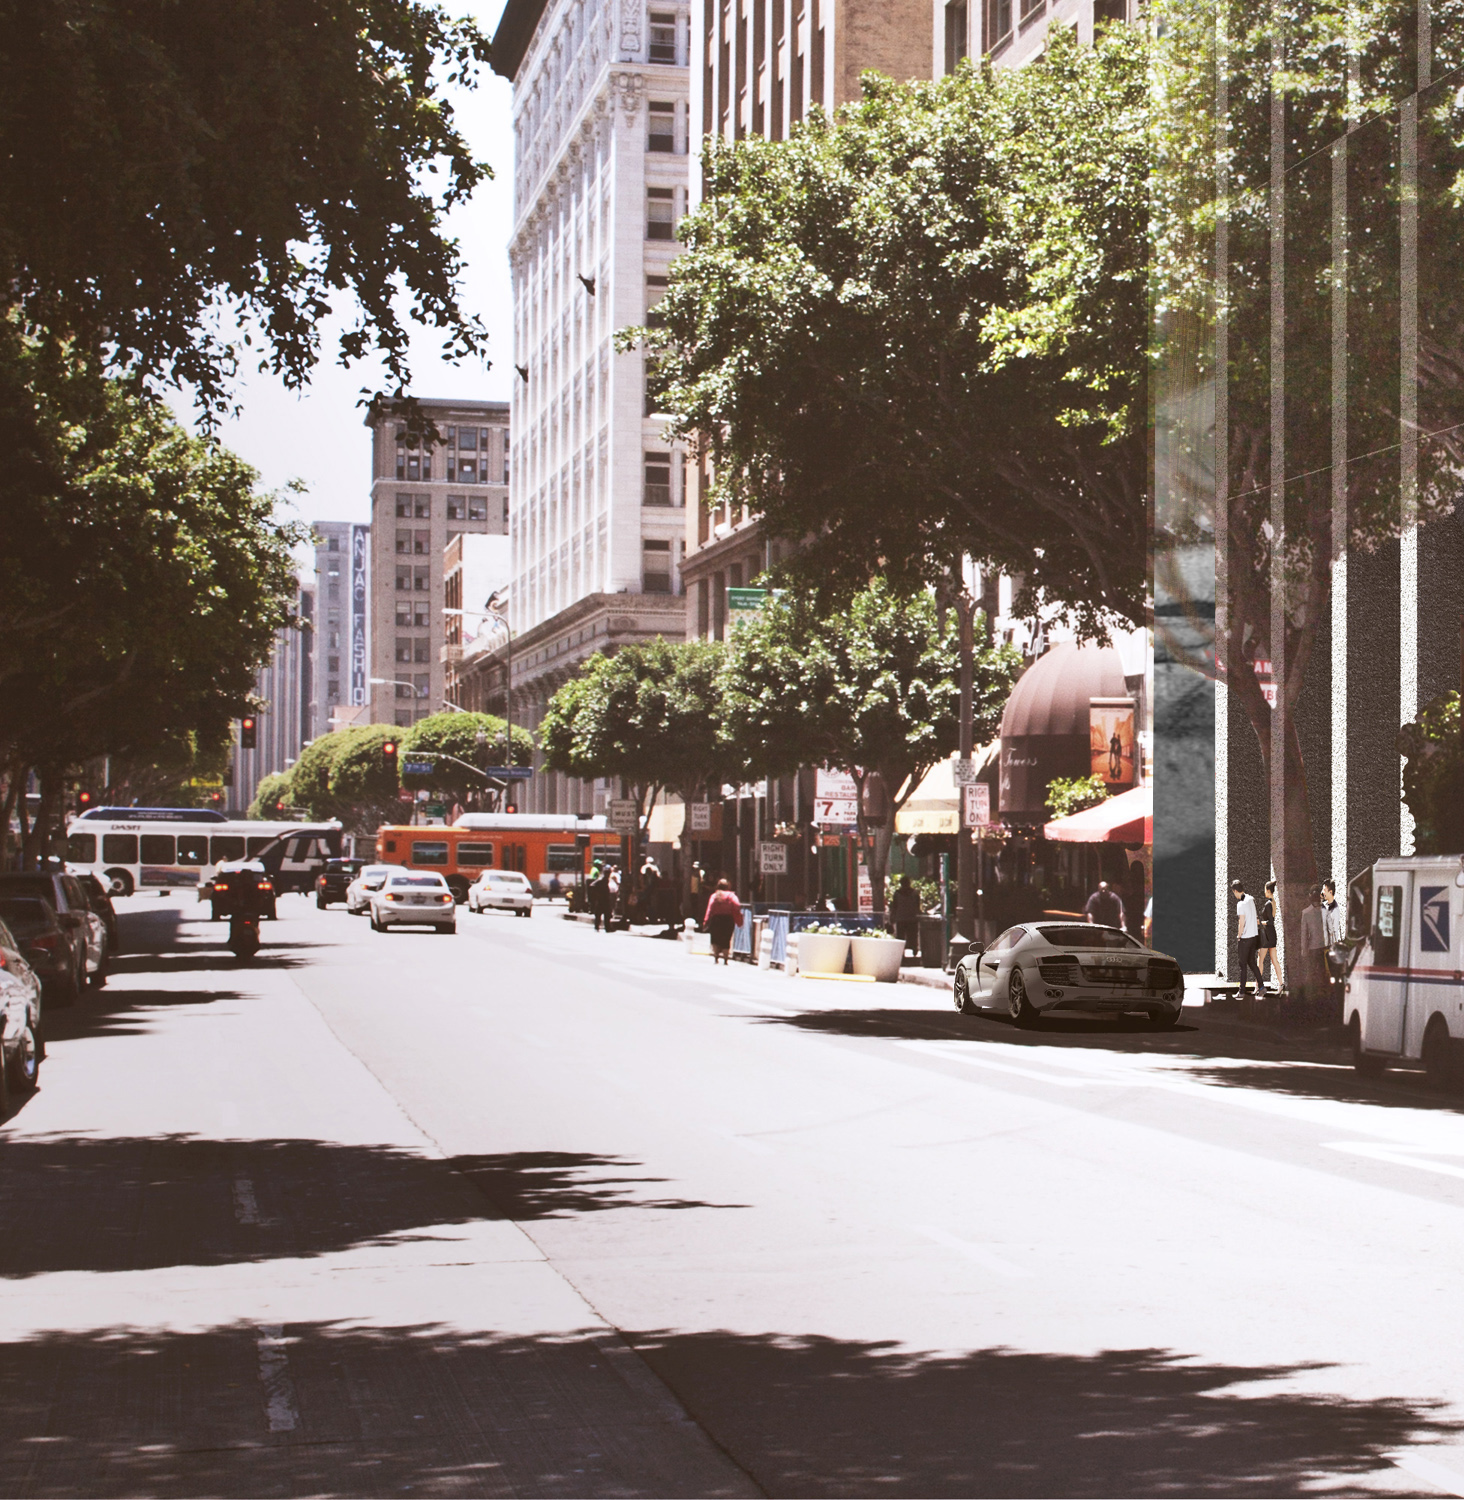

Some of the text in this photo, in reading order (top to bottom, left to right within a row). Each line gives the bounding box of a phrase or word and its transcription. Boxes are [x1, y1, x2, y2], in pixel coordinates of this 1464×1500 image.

[354, 528, 366, 602] ANJAC
[762, 844, 785, 852] RIGHT
[763, 853, 784, 861] TURN
[763, 863, 784, 871] ONLY
